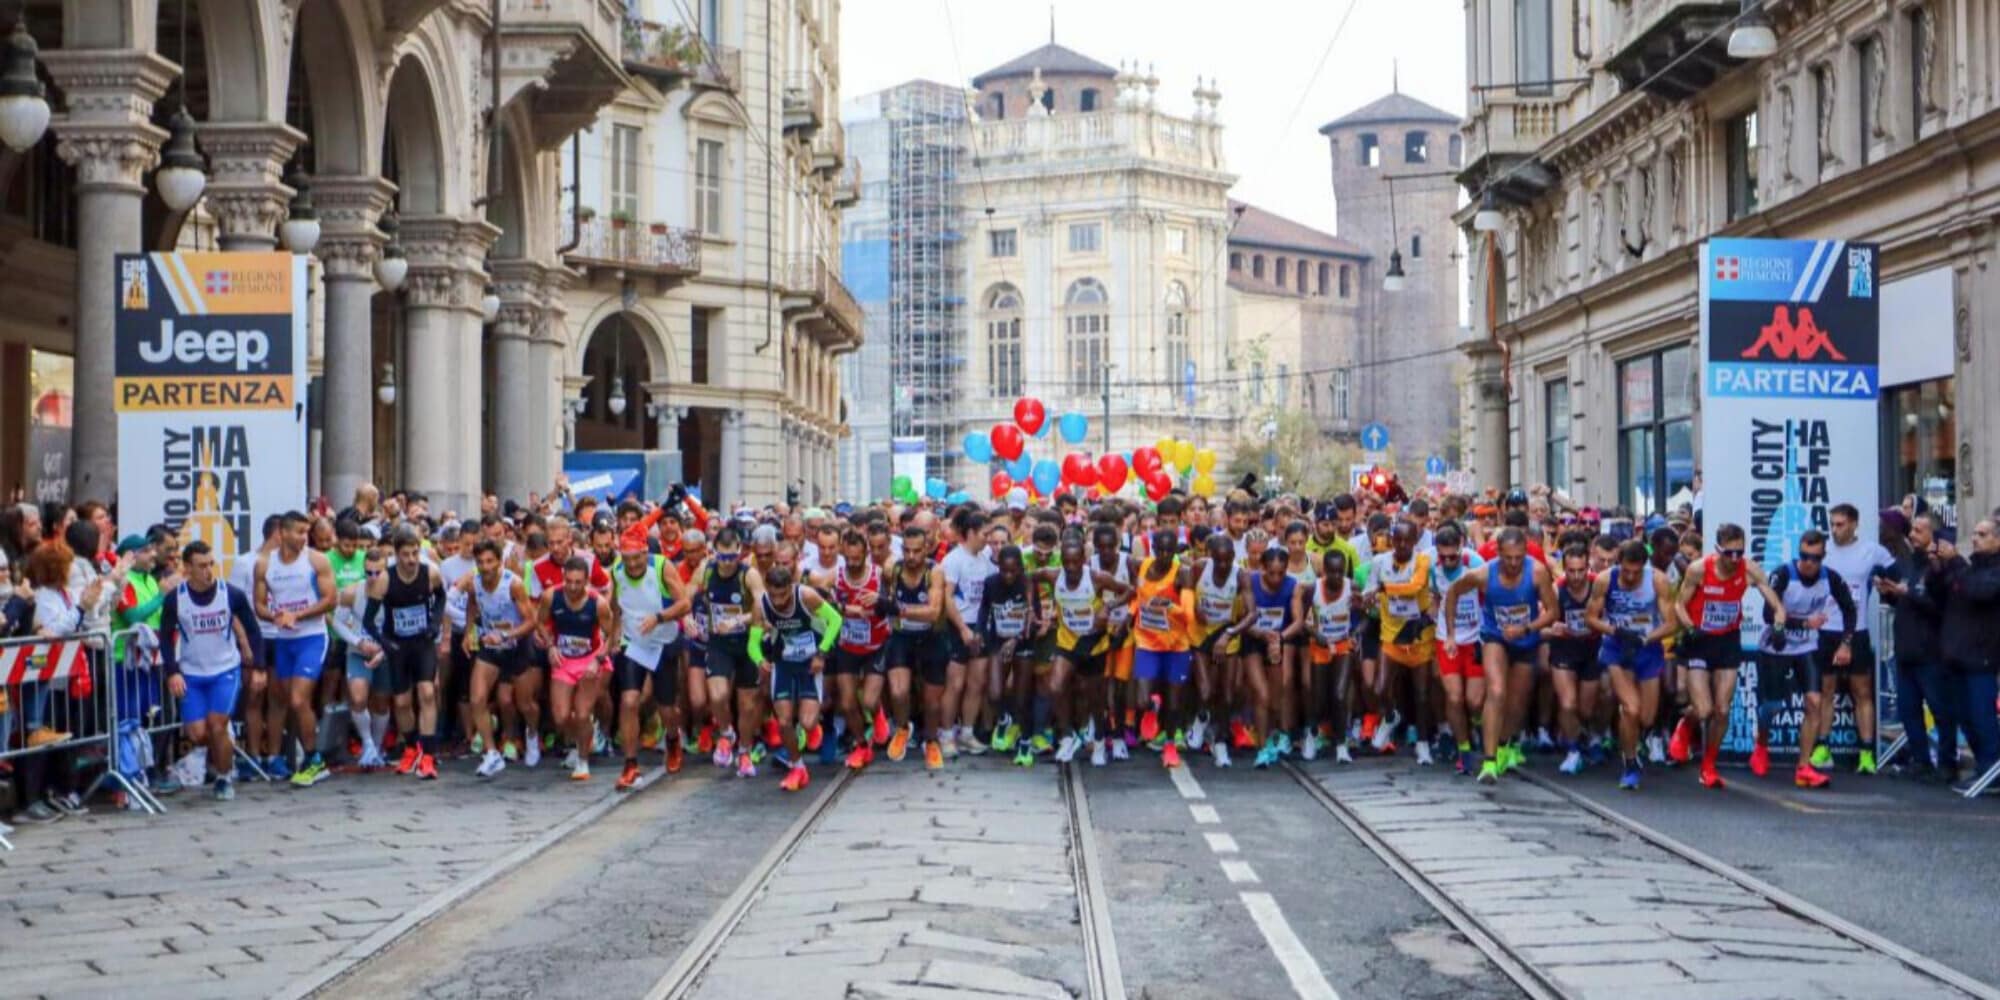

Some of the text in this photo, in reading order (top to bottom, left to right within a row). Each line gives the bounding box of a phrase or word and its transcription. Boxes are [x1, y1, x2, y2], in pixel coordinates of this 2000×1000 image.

[138, 319, 269, 371] Jeep
[123, 382, 284, 405] PARTENZA
[1715, 367, 1872, 395] PARTENZA
[163, 427, 191, 491] CITY
[192, 426, 250, 467] MA
[1751, 418, 1784, 480] CITY
[192, 470, 250, 511] RA
